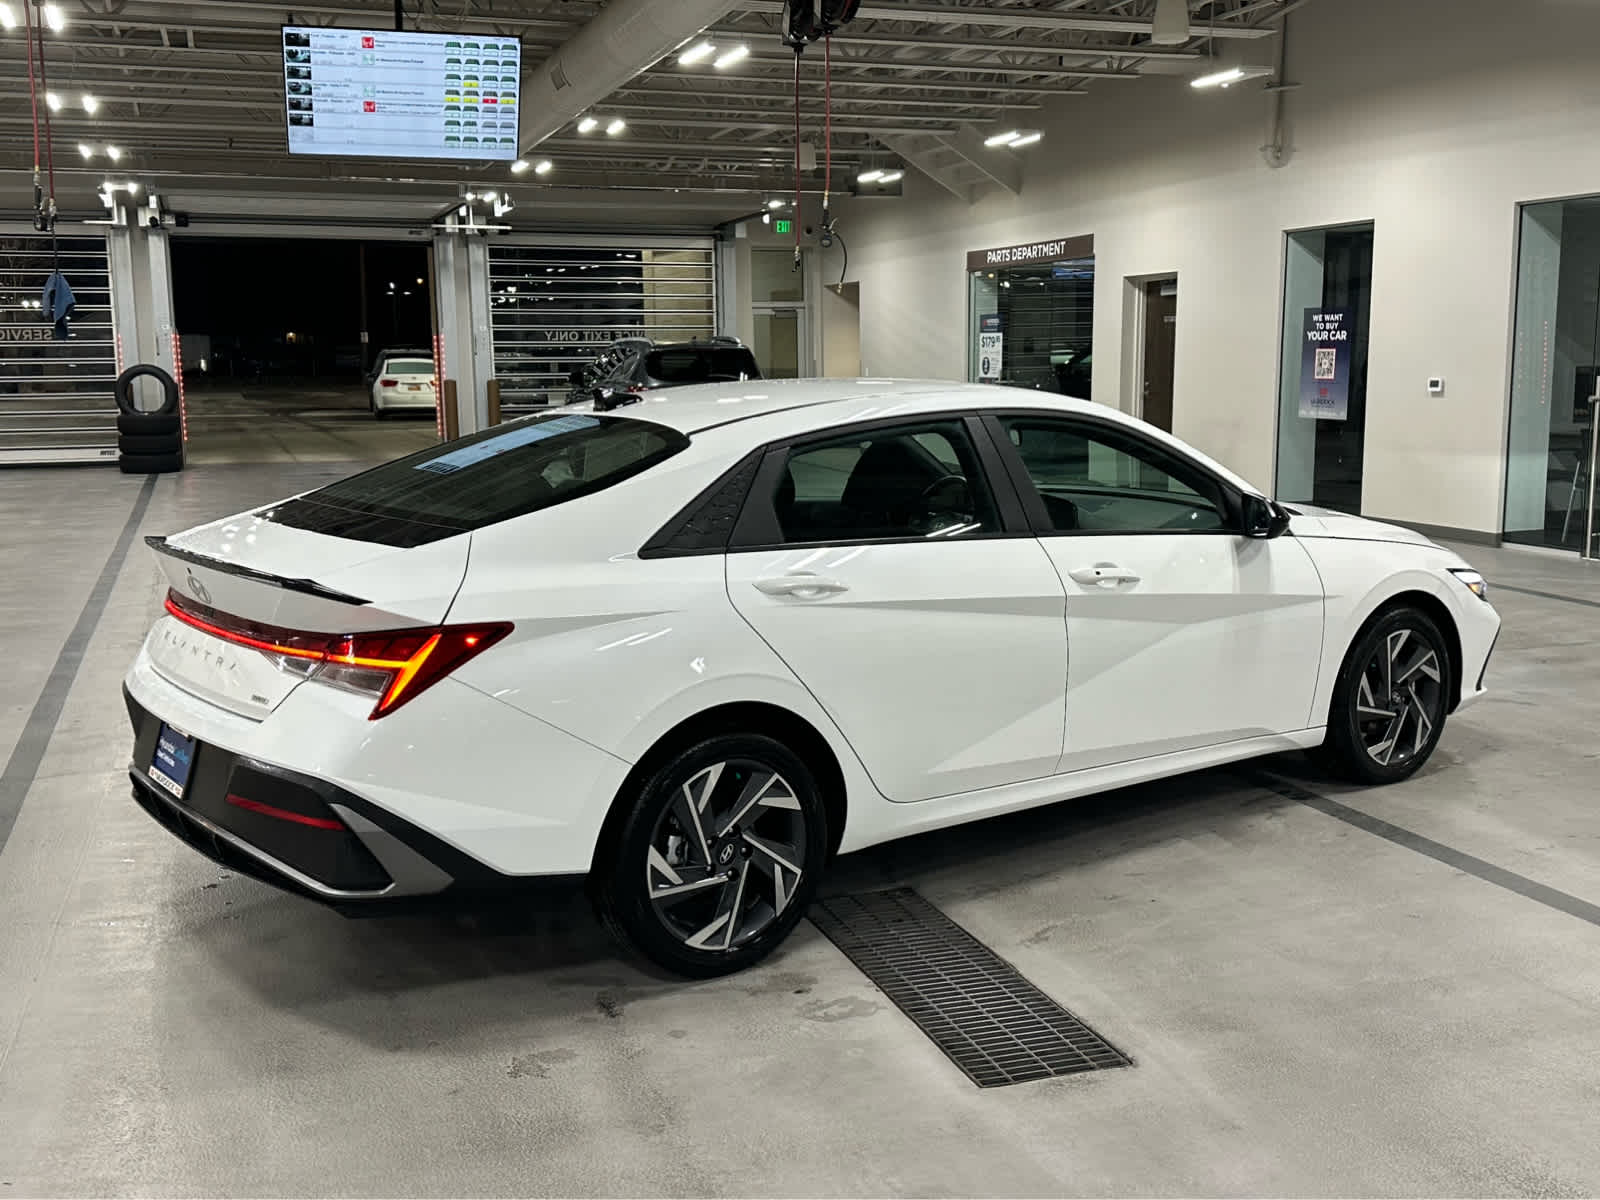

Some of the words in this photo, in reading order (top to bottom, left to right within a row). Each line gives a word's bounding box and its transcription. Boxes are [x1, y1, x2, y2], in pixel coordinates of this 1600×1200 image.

[986, 249, 1011, 263] PARTS
[1011, 241, 1066, 261] DEPARTMENT
[1312, 314, 1322, 322] WE
[1324, 313, 1343, 322] WANT
[1316, 322, 1324, 330] TO
[1325, 322, 1339, 330] BUY
[1307, 331, 1329, 341] YOUR
[1329, 330, 1347, 340] CAR
